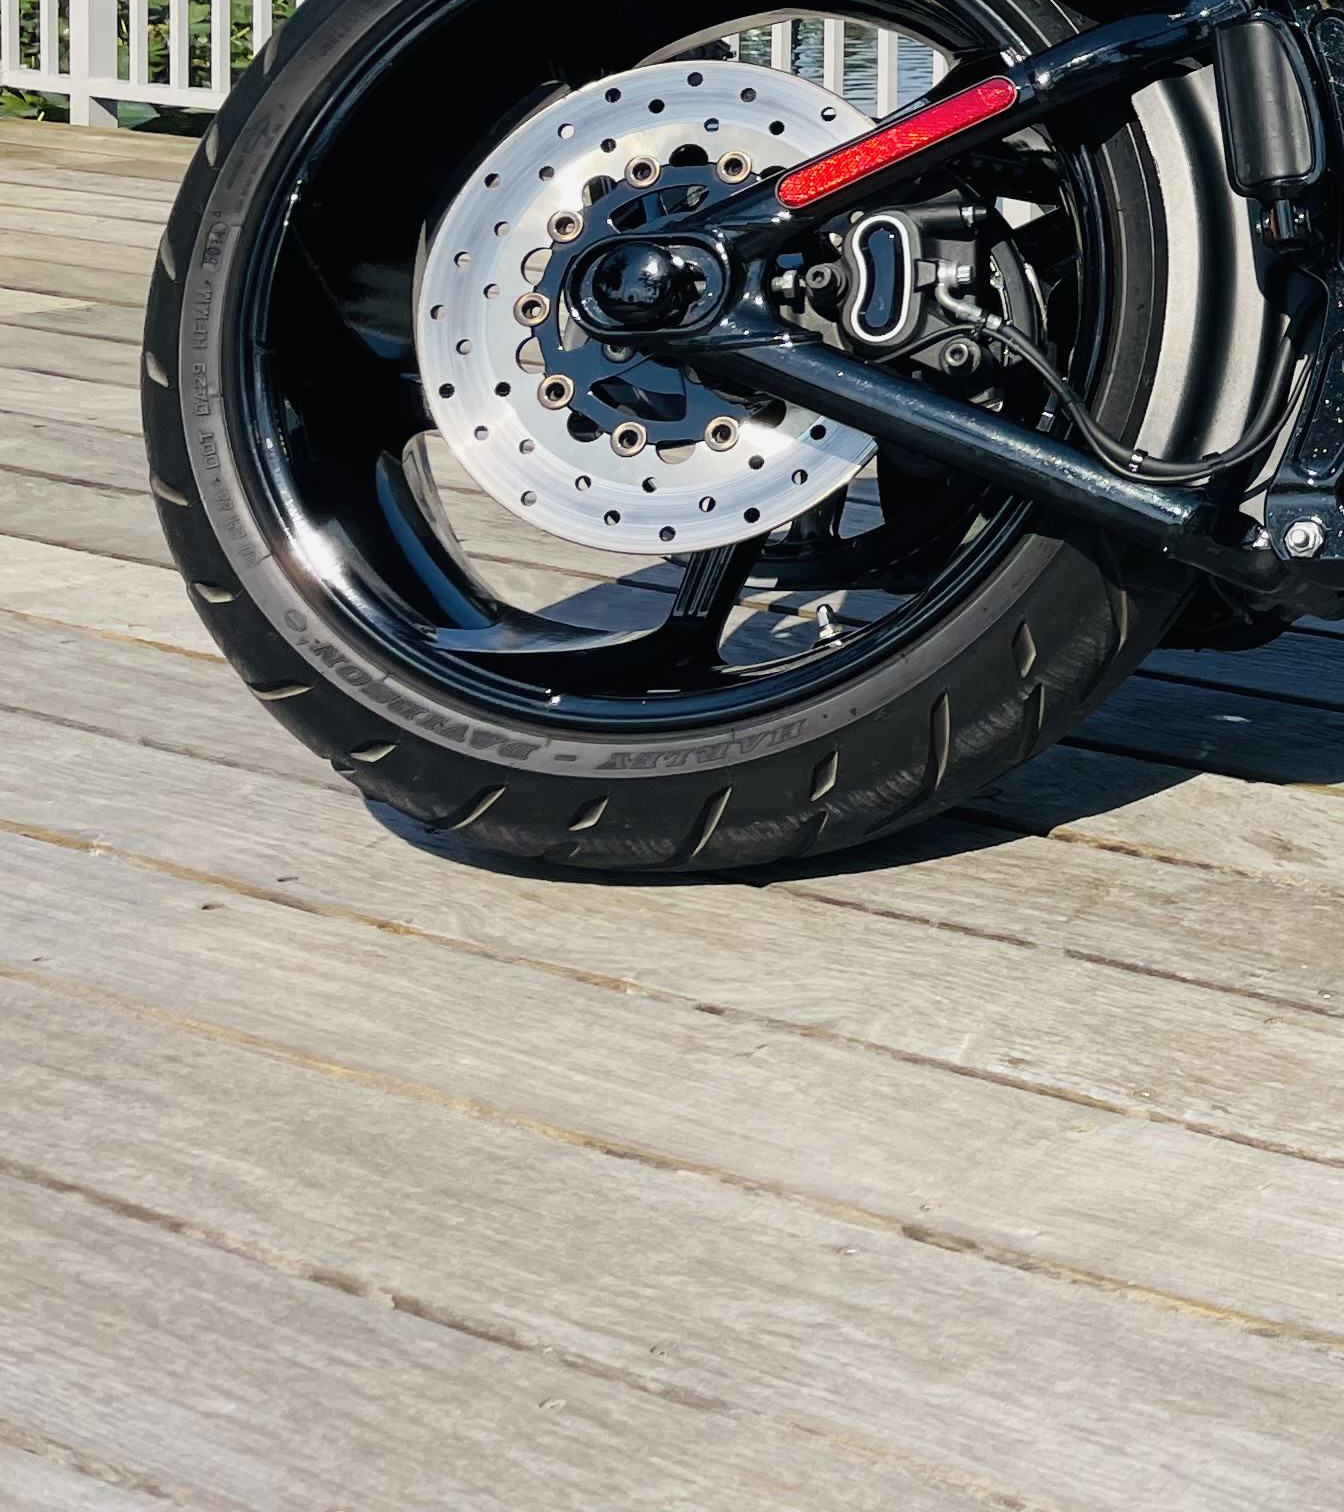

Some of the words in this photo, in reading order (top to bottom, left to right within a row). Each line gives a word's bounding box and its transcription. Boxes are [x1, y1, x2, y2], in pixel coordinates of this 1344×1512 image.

[199, 432, 221, 470] DOT
[307, 641, 541, 761] DAVIDSON
[596, 718, 808, 771] HARLEY
